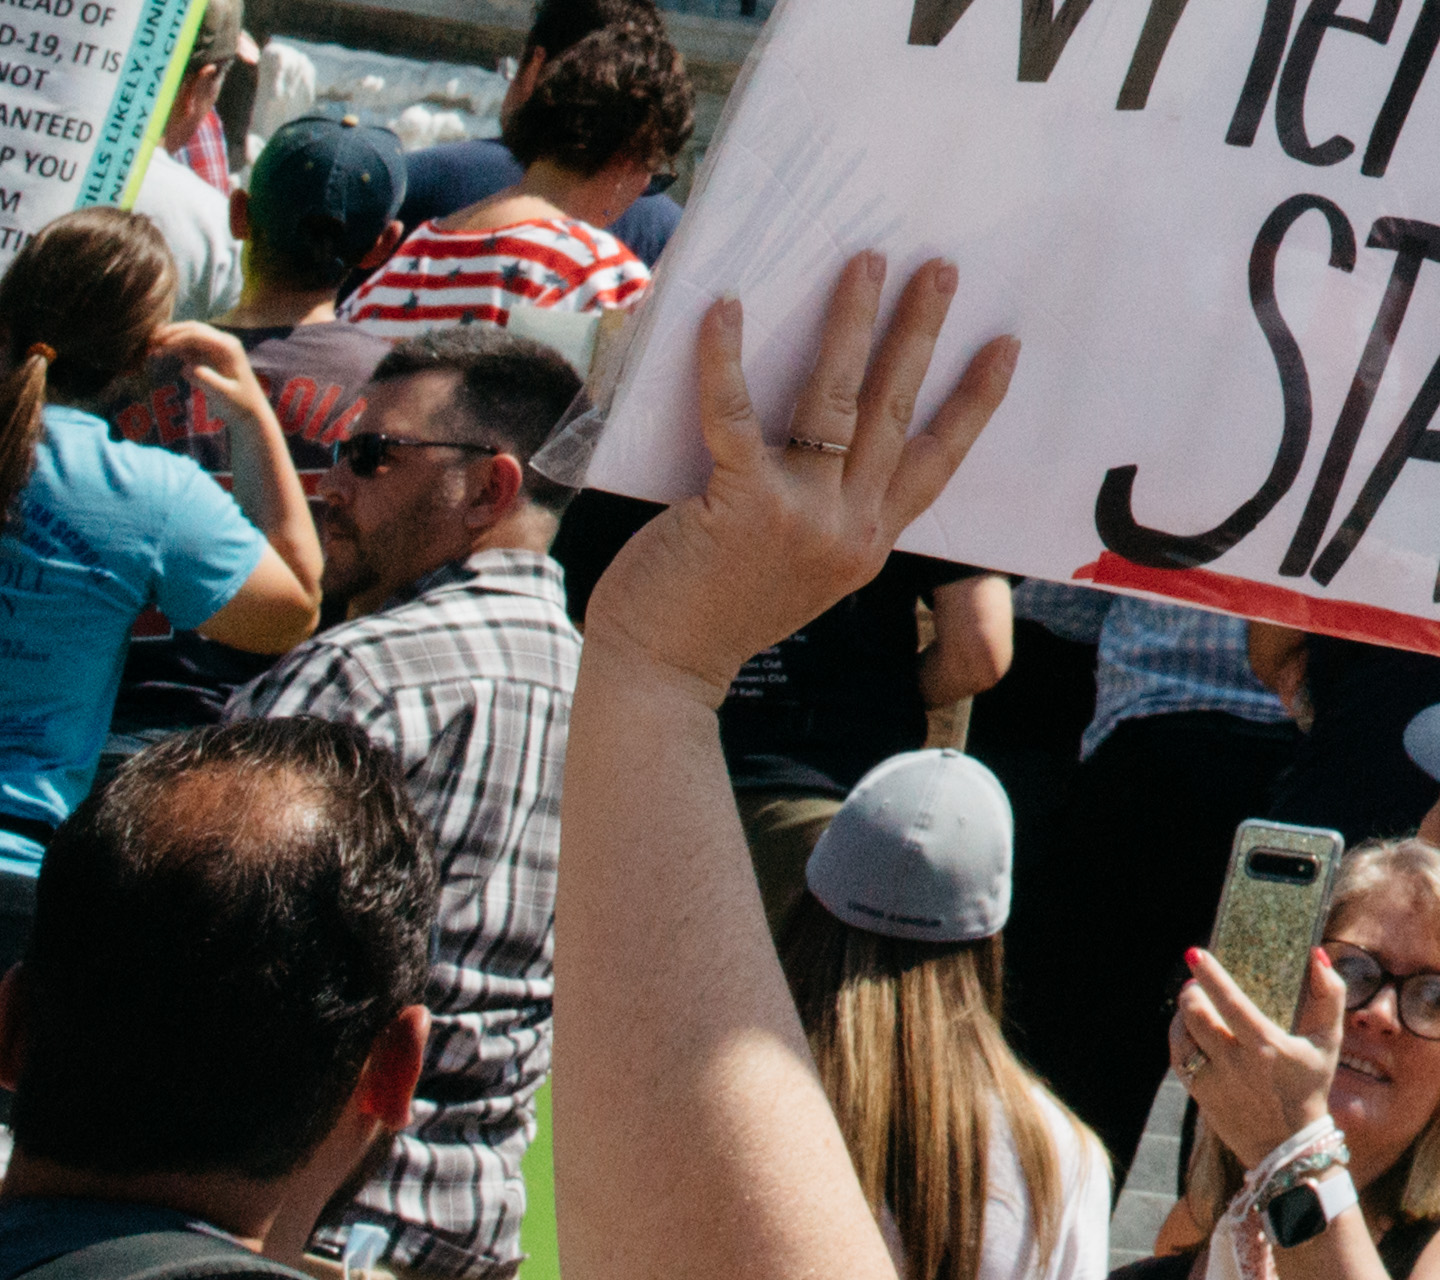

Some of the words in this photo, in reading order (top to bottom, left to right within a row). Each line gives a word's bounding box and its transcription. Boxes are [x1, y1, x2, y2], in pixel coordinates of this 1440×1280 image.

[81, 2, 117, 28] OF
[73, 41, 98, 67] IT
[101, 49, 122, 74] IS
[106, 56, 151, 144] LIKELY,
[132, 106, 149, 139] BY
[146, 65, 164, 98] PA
[25, 151, 78, 183] YOU
